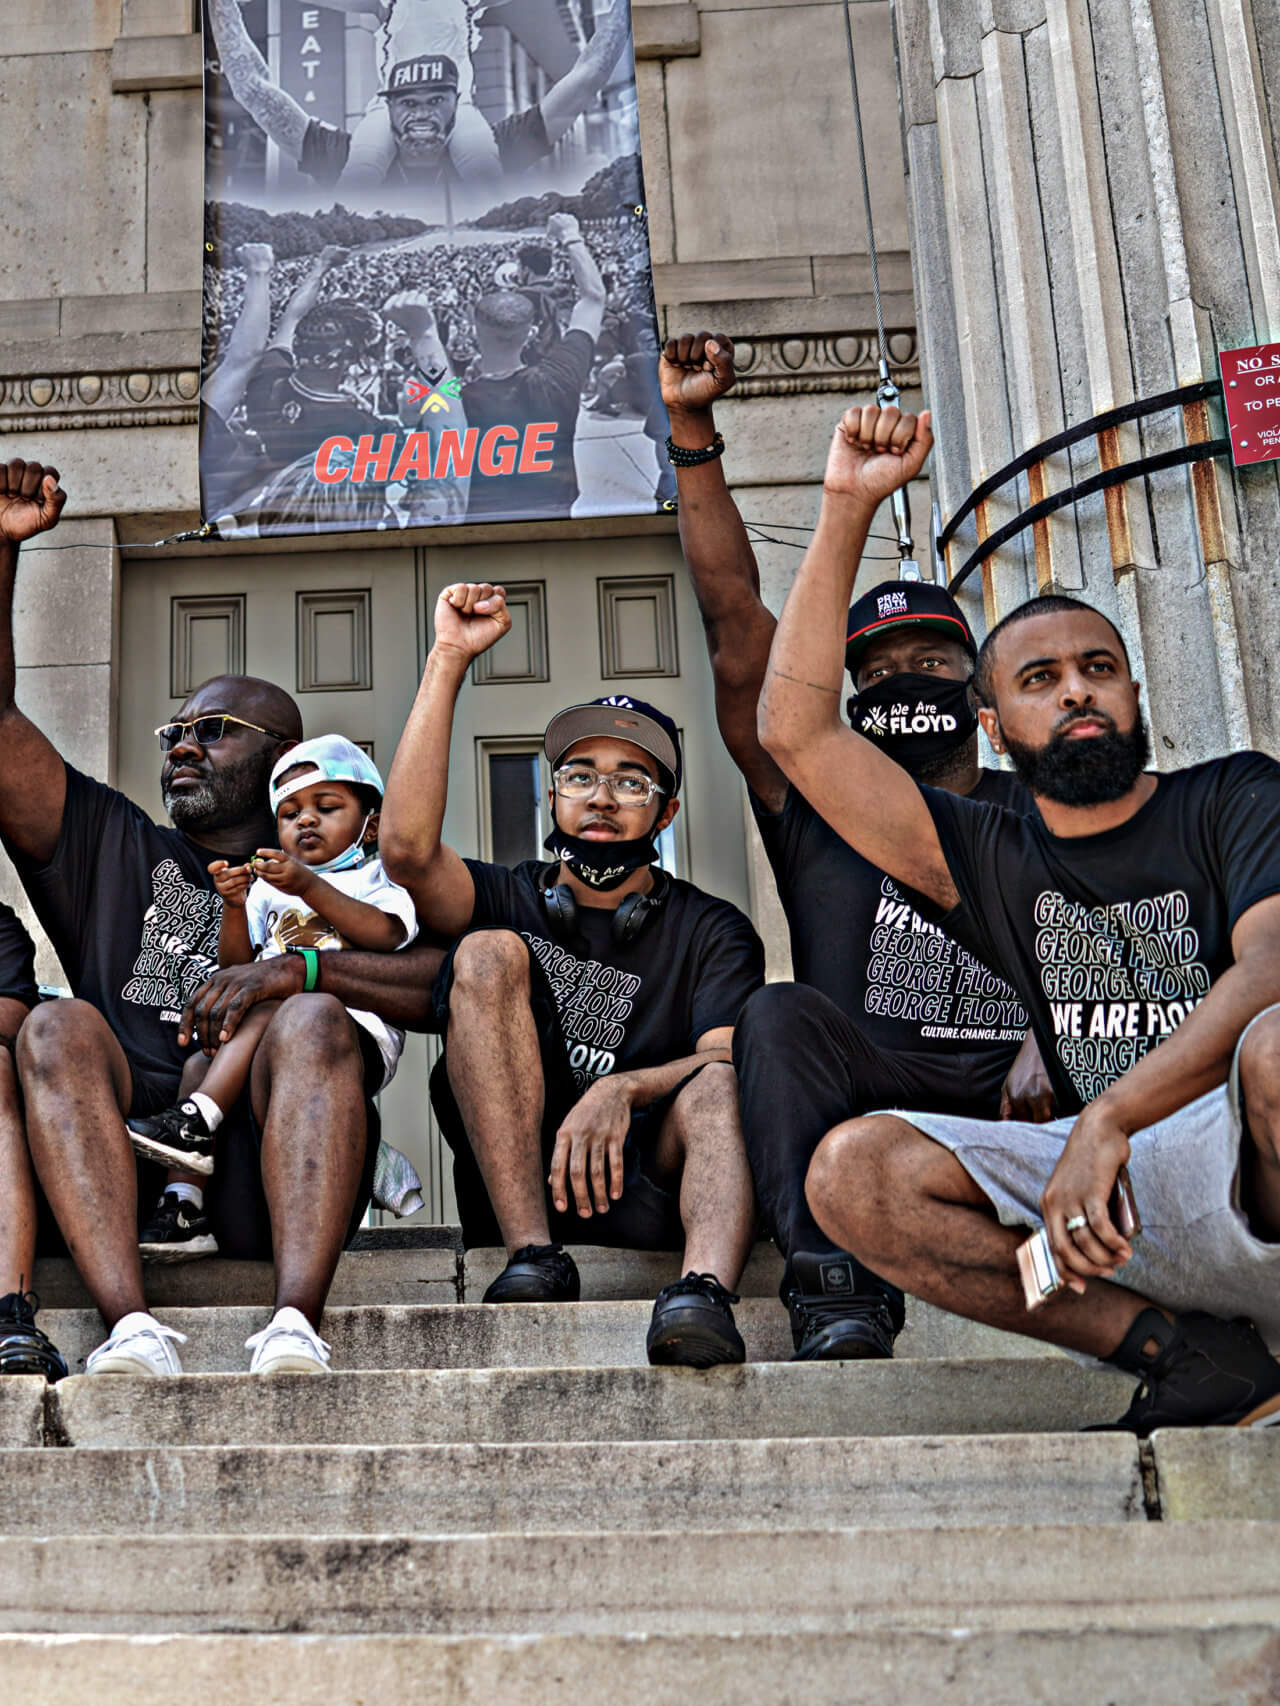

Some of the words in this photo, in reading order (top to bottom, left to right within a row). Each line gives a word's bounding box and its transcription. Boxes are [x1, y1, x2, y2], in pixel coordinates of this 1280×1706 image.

[393, 61, 443, 88] FAITH
[1236, 357, 1263, 371] NO
[1255, 375, 1275, 387] OR
[1243, 400, 1263, 412] TO
[314, 422, 559, 483] CHANGE
[876, 592, 906, 605] PRAY
[890, 703, 910, 716] We
[915, 701, 937, 715] Are
[890, 714, 958, 735] FLOYD
[875, 897, 912, 931] WE
[870, 924, 953, 964] GEORGE
[1035, 927, 1124, 967] GEORGE
[1129, 927, 1199, 970] FLOYD
[578, 960, 642, 998] FLOYD
[867, 953, 954, 993] GEORGE
[956, 967, 1021, 1001] FLO
[1041, 964, 1135, 1001] GEORGE
[1134, 962, 1210, 1001] FLOYD
[565, 986, 633, 1022] FLOYD
[865, 984, 953, 1023] GEORGE
[955, 996, 1029, 1027] FLOYD
[1049, 1002, 1083, 1036] WE
[1089, 1002, 1140, 1038] ARE
[1146, 998, 1204, 1036] FLO
[560, 1008, 625, 1049] FLOYD
[920, 1025, 1028, 1041] CULTURE.CHANGE.JUSTIC
[566, 1039, 616, 1076] OYD
[1056, 1035, 1149, 1075] GEORGE
[1069, 1071, 1120, 1104] GEO
